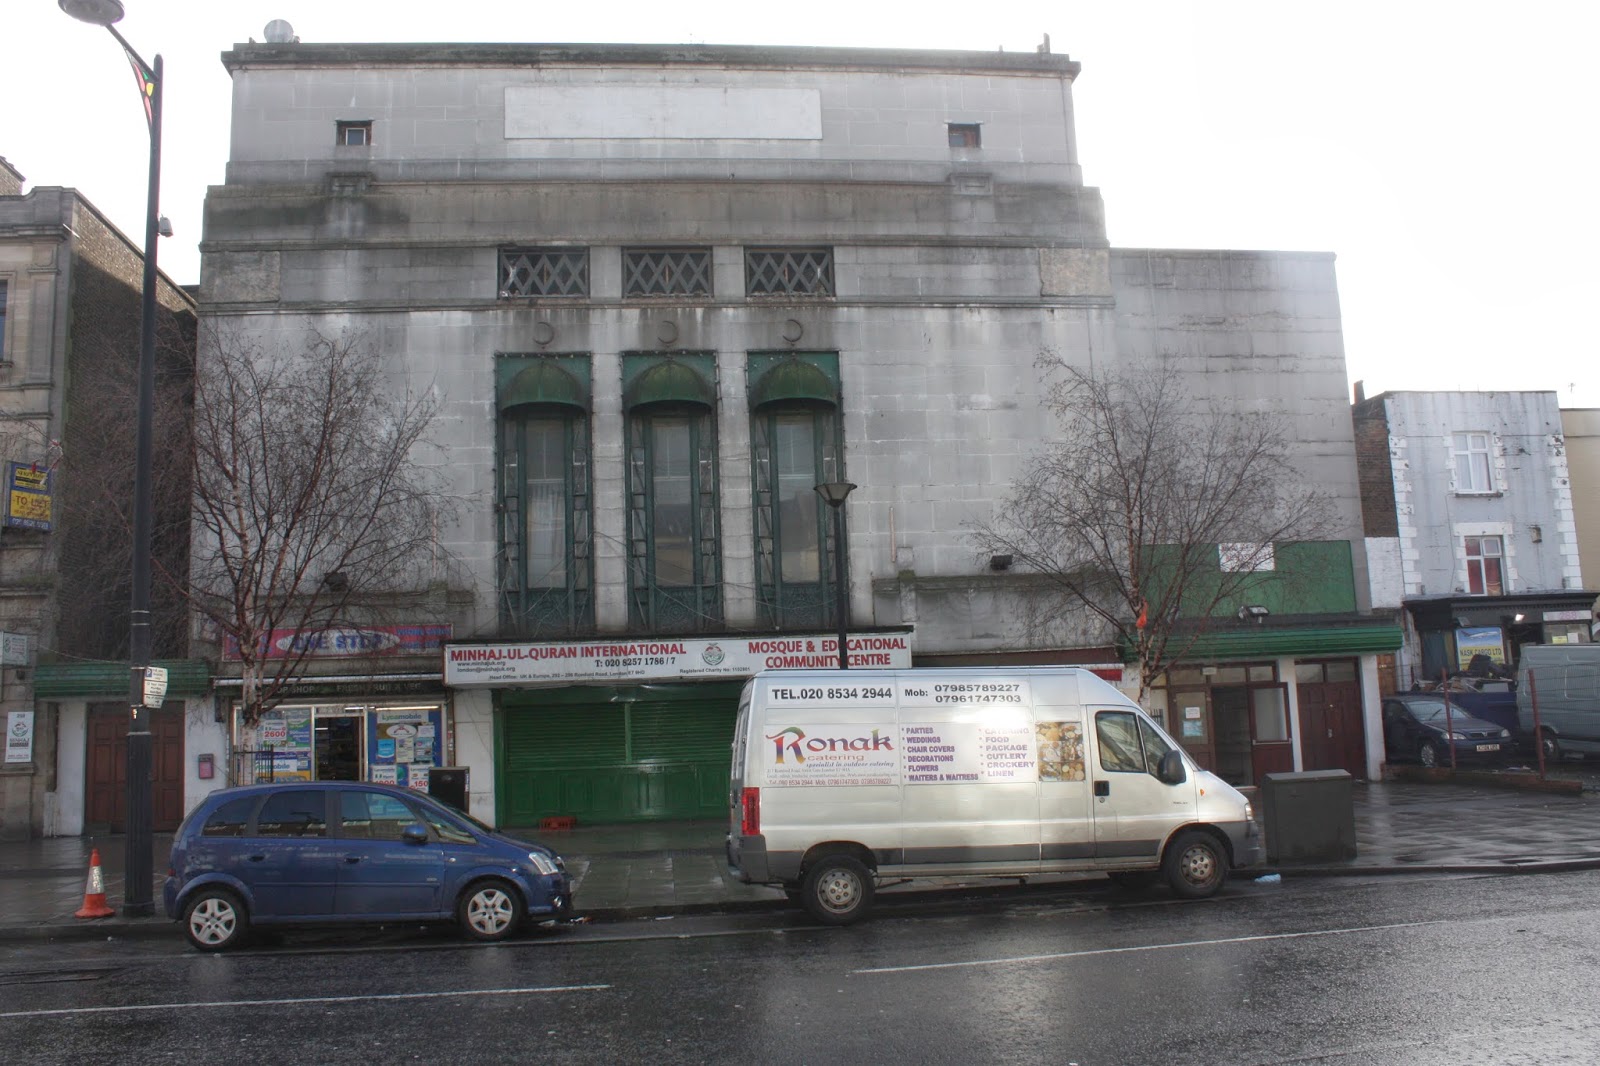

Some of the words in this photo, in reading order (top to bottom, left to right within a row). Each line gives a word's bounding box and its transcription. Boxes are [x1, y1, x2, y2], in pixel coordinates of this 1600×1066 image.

[15, 495, 28, 506] TO
[335, 634, 383, 649] STOP
[450, 646, 577, 661] MINHAJ-UL-QURAN
[581, 643, 687, 657] INTERNATIONAL
[748, 641, 802, 654] MOSQUE
[806, 641, 815, 653] &
[605, 659, 620, 667] 020
[622, 658, 642, 667] 8257
[644, 657, 664, 665] 1786
[670, 657, 676, 665] 7
[765, 656, 840, 668] COMMUNITY
[847, 653, 891, 666] CENTRE
[934, 684, 1020, 692] 07985789227
[827, 687, 859, 700] 8534
[861, 687, 893, 699] 2944
[904, 689, 928, 697] Mob:
[935, 695, 1022, 703] 07961747303
[765, 726, 895, 765] Ronak
[929, 745, 955, 753] COVERS
[807, 754, 865, 762] catering
[907, 755, 954, 763] DECORATIONS
[908, 764, 939, 772] FLOWERS
[987, 761, 1035, 769] CROCKERY
[908, 774, 938, 782] WAITERS
[946, 773, 979, 781] WAITRESS
